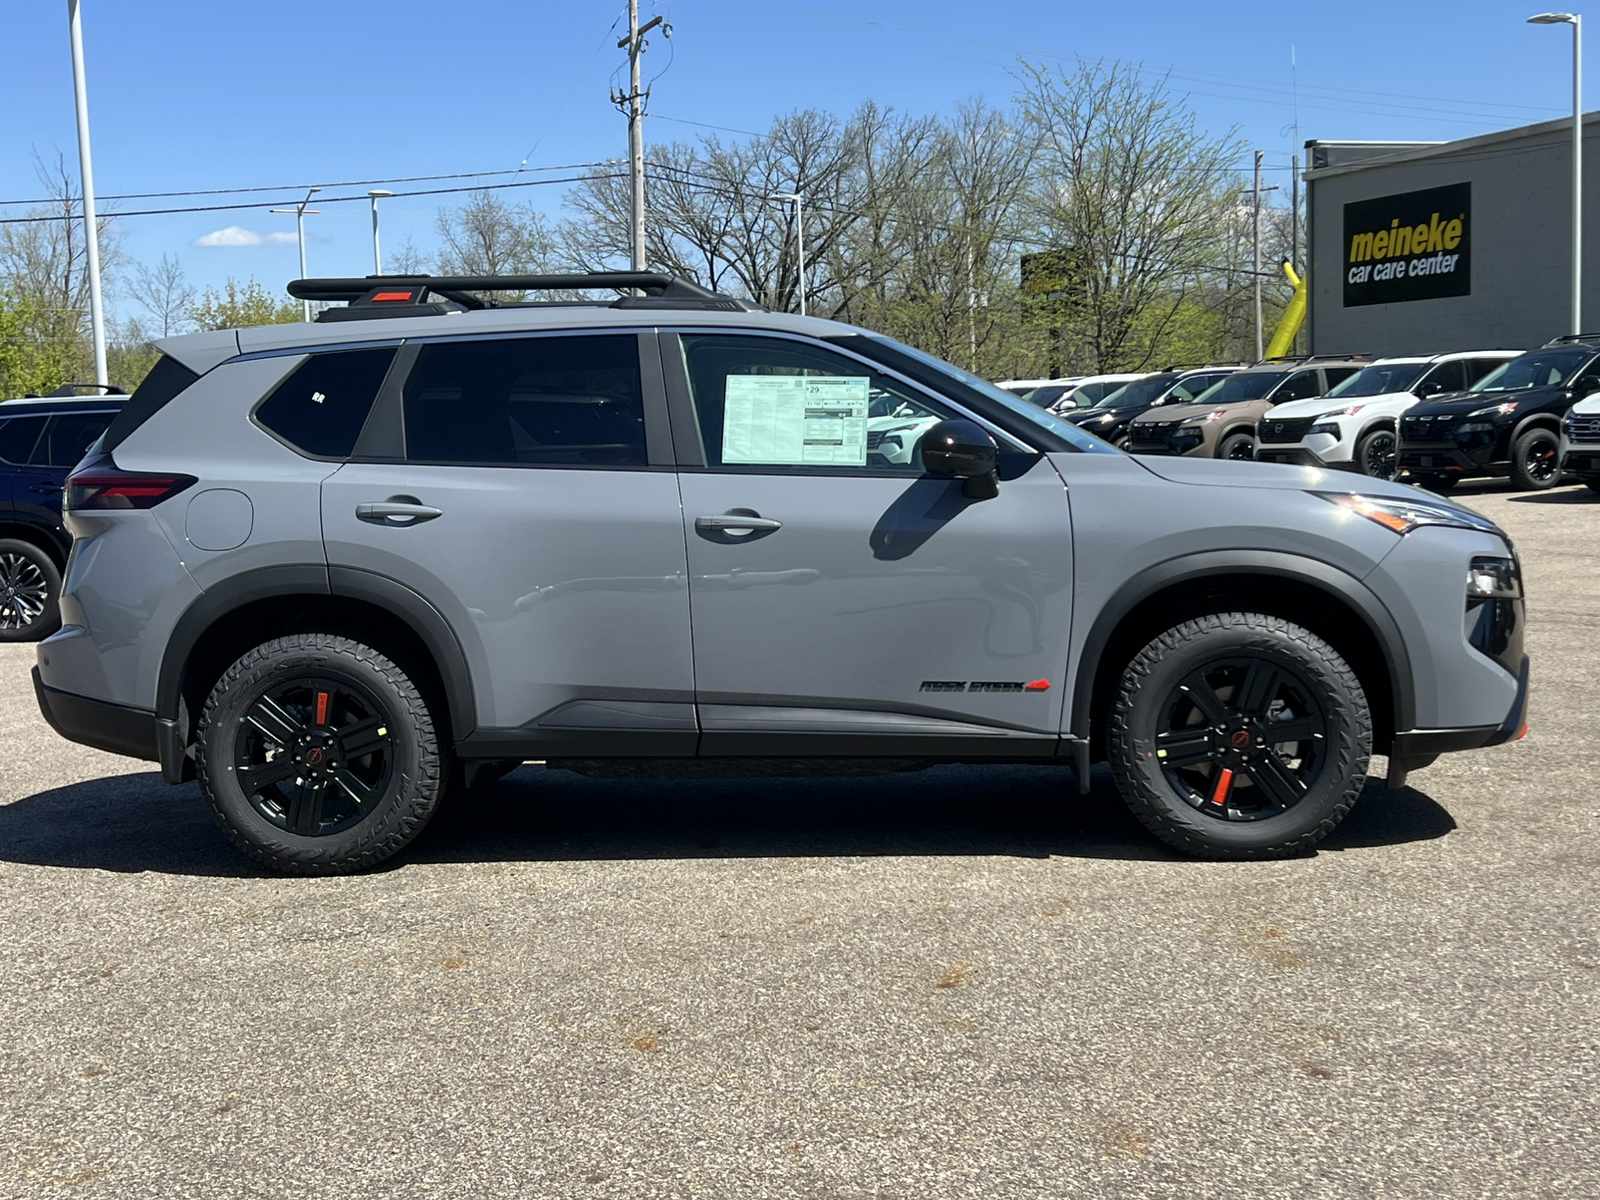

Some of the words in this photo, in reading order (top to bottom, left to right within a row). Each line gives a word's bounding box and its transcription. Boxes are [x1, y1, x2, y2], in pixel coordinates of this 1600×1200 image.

[1349, 212, 1463, 263] meineke
[1348, 264, 1372, 285] car
[1373, 260, 1406, 281] care
[1408, 252, 1459, 277] center
[810, 386, 820, 394] 29
[311, 391, 326, 404] RR
[918, 681, 967, 693] ROCK
[967, 681, 1025, 693] CREEK
